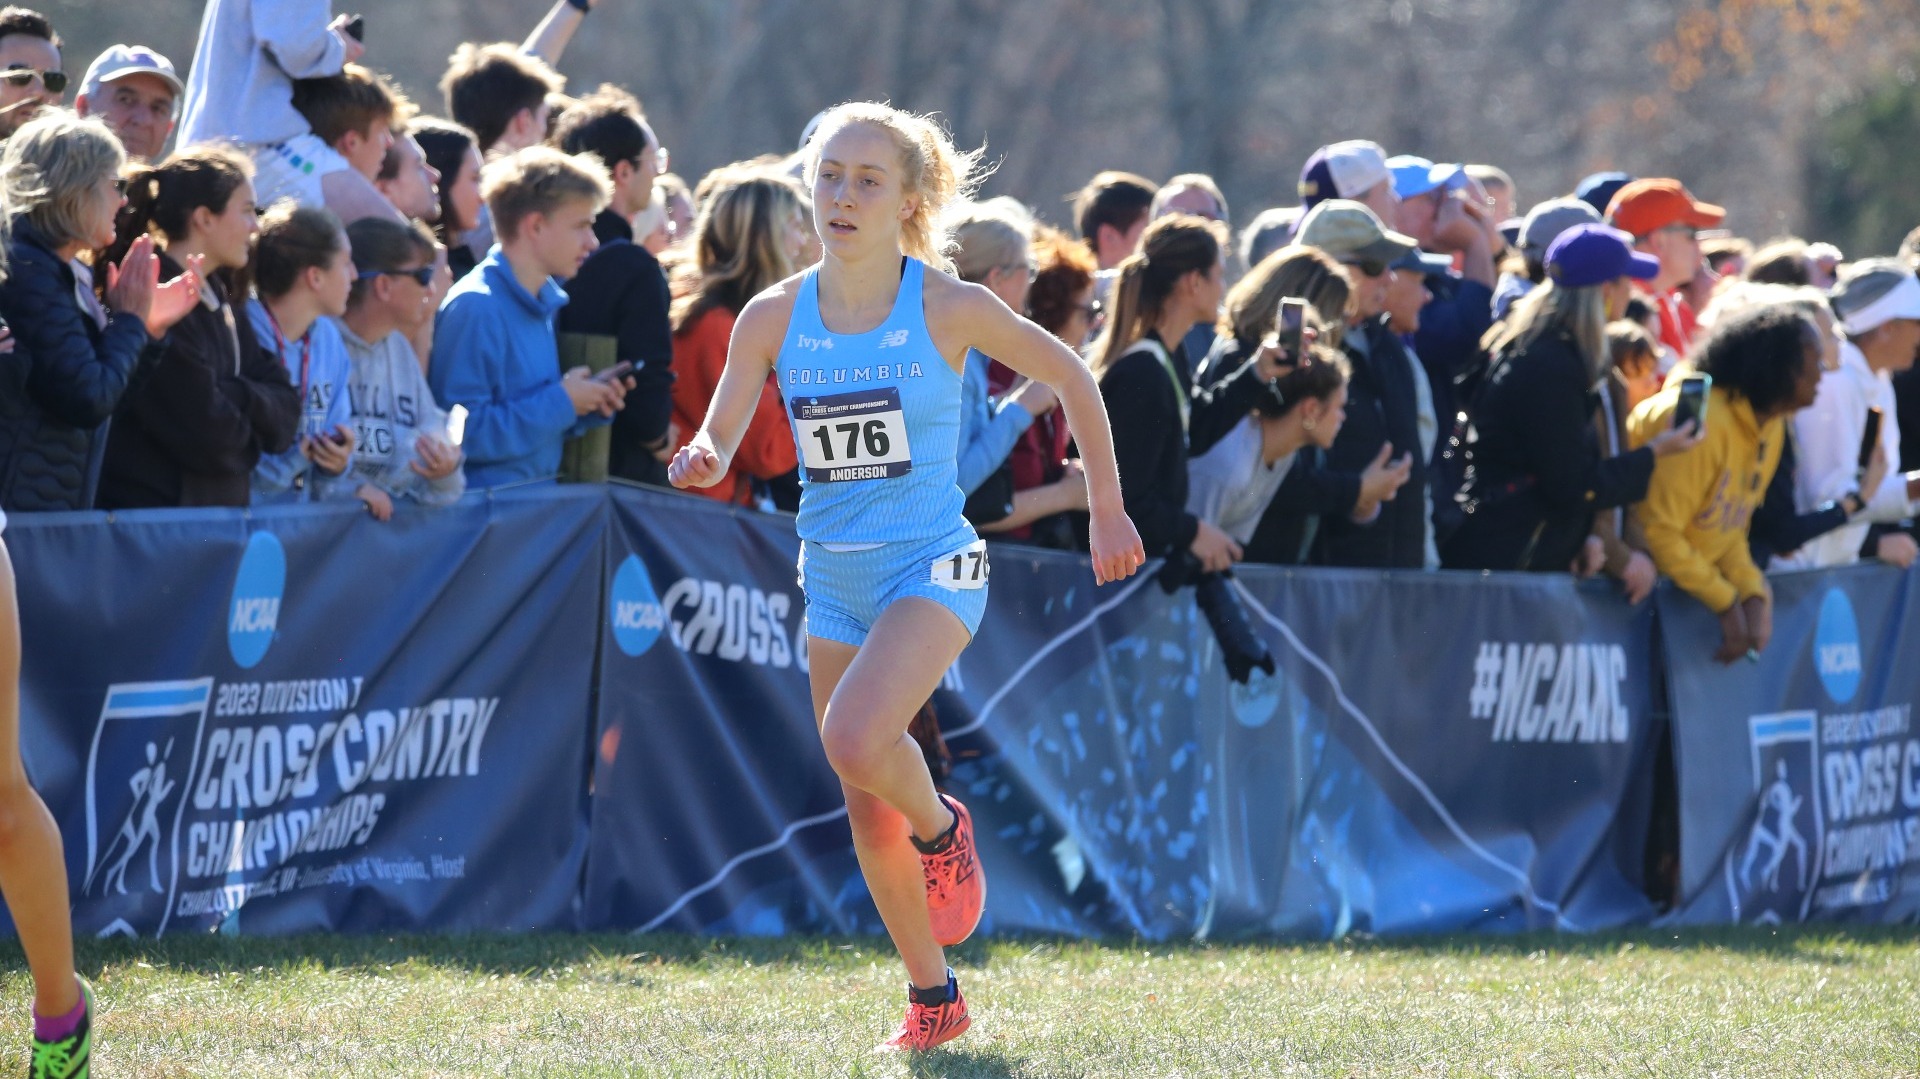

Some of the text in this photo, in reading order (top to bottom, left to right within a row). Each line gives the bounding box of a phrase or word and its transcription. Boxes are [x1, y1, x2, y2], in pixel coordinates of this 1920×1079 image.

[789, 361, 924, 385] COLUMBIA
[827, 404, 850, 413] COUNTRY
[849, 400, 889, 410] CHAMPIONSHIPS
[812, 419, 891, 461] 176
[829, 465, 888, 482] ANDERSON
[230, 596, 280, 634] NCAA
[615, 601, 665, 632] NCAA
[663, 576, 793, 670] CROSS
[214, 681, 261, 717] 2023
[259, 677, 350, 715] DIVISION
[1469, 640, 1630, 744] #NCAAXC
